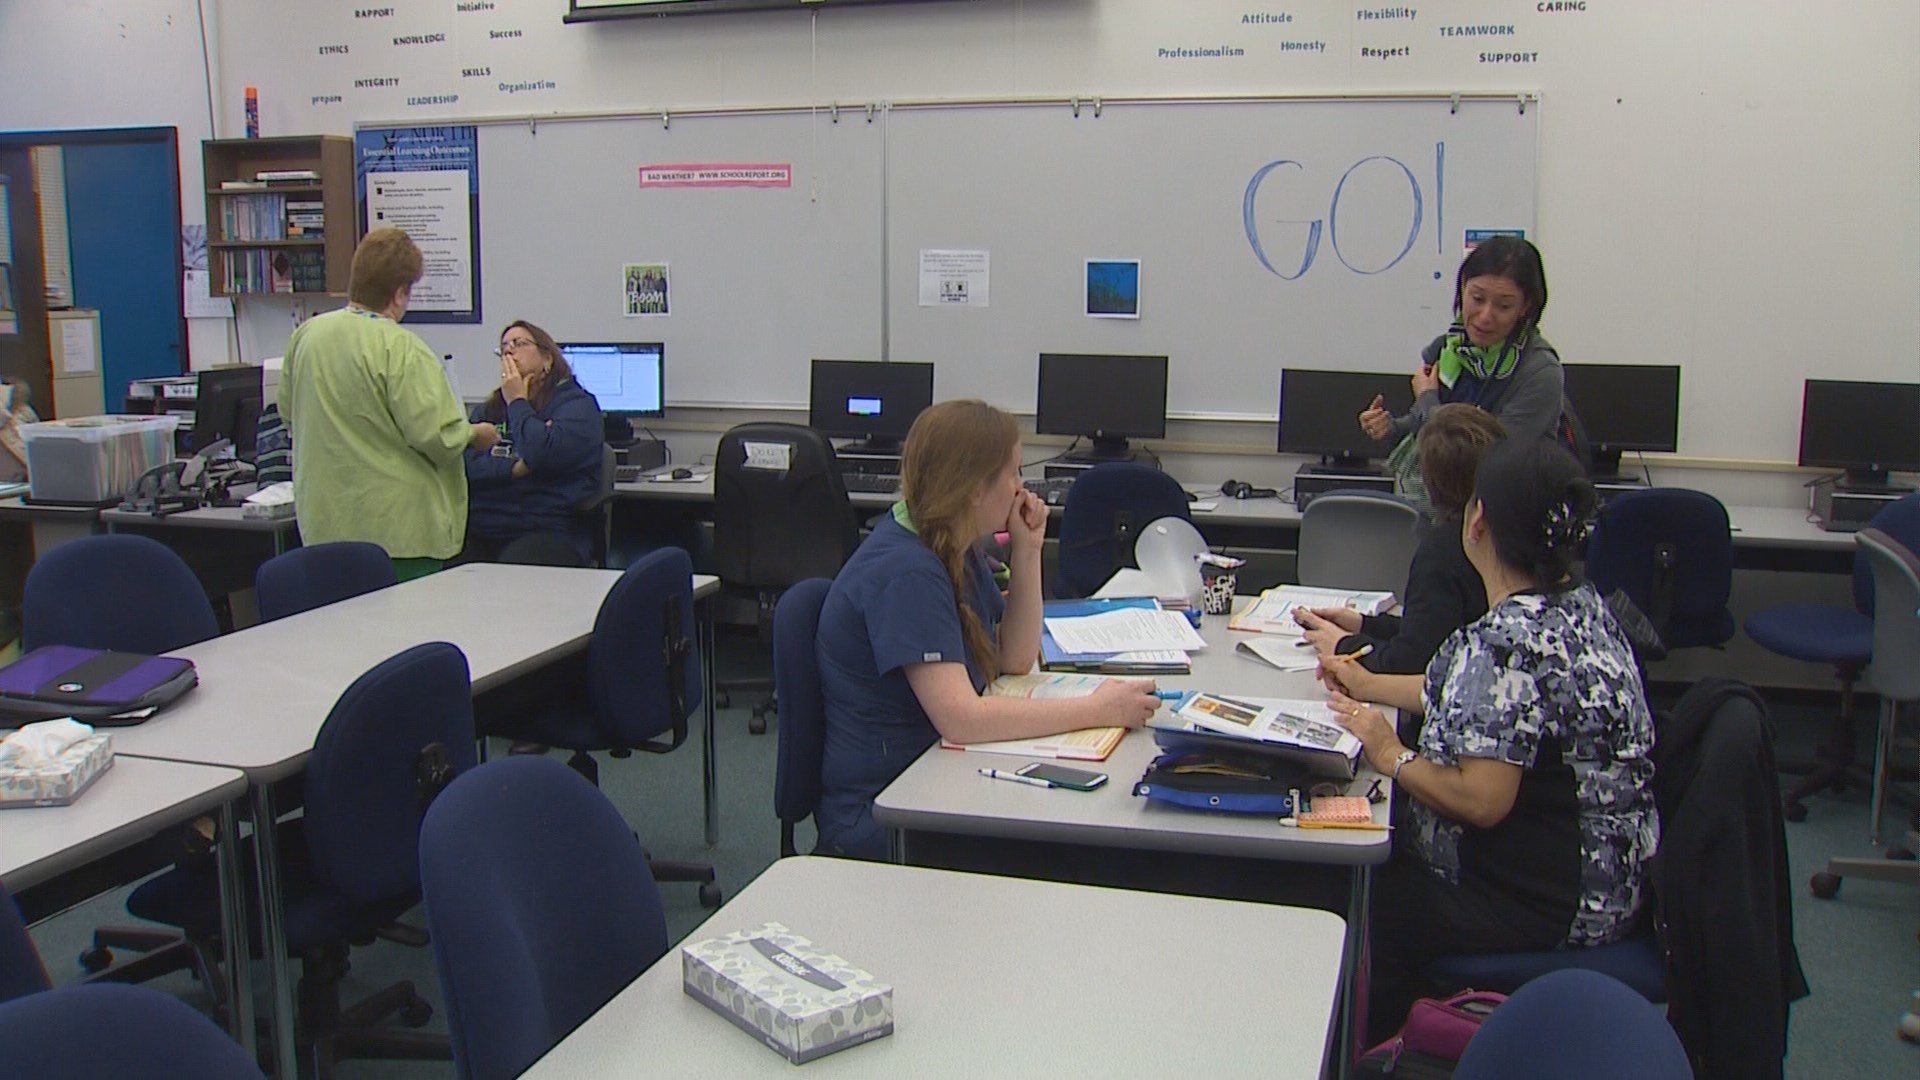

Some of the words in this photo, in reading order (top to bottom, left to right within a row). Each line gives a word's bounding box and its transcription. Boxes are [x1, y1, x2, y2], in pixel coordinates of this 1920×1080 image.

[456, 1, 495, 12] Initiative
[1536, 0, 1587, 13] CARING
[354, 8, 394, 19] RAPPORT
[1241, 12, 1293, 24] Attitude
[1357, 7, 1417, 21] Flexibility
[489, 29, 523, 40] Success
[1439, 24, 1515, 37] TEAMWORK
[392, 33, 446, 46] KNOWLEDGE
[318, 44, 349, 55] ETHICS
[1158, 45, 1245, 59] Professionalism
[1280, 39, 1327, 54] Honesty
[1361, 45, 1410, 61] Respect
[1479, 52, 1539, 63] SUPPORT
[461, 66, 492, 78] SKILLS
[354, 77, 400, 89] INTEGRITY
[498, 79, 556, 94] Organization
[311, 95, 343, 106] prepare
[406, 94, 460, 106] LEADERSHIP
[397, 144, 431, 156] Learning
[430, 144, 471, 155] Outcomes
[647, 173, 661, 181] BAD
[661, 172, 696, 180] WEATHER?
[1242, 141, 1445, 281] GO!
